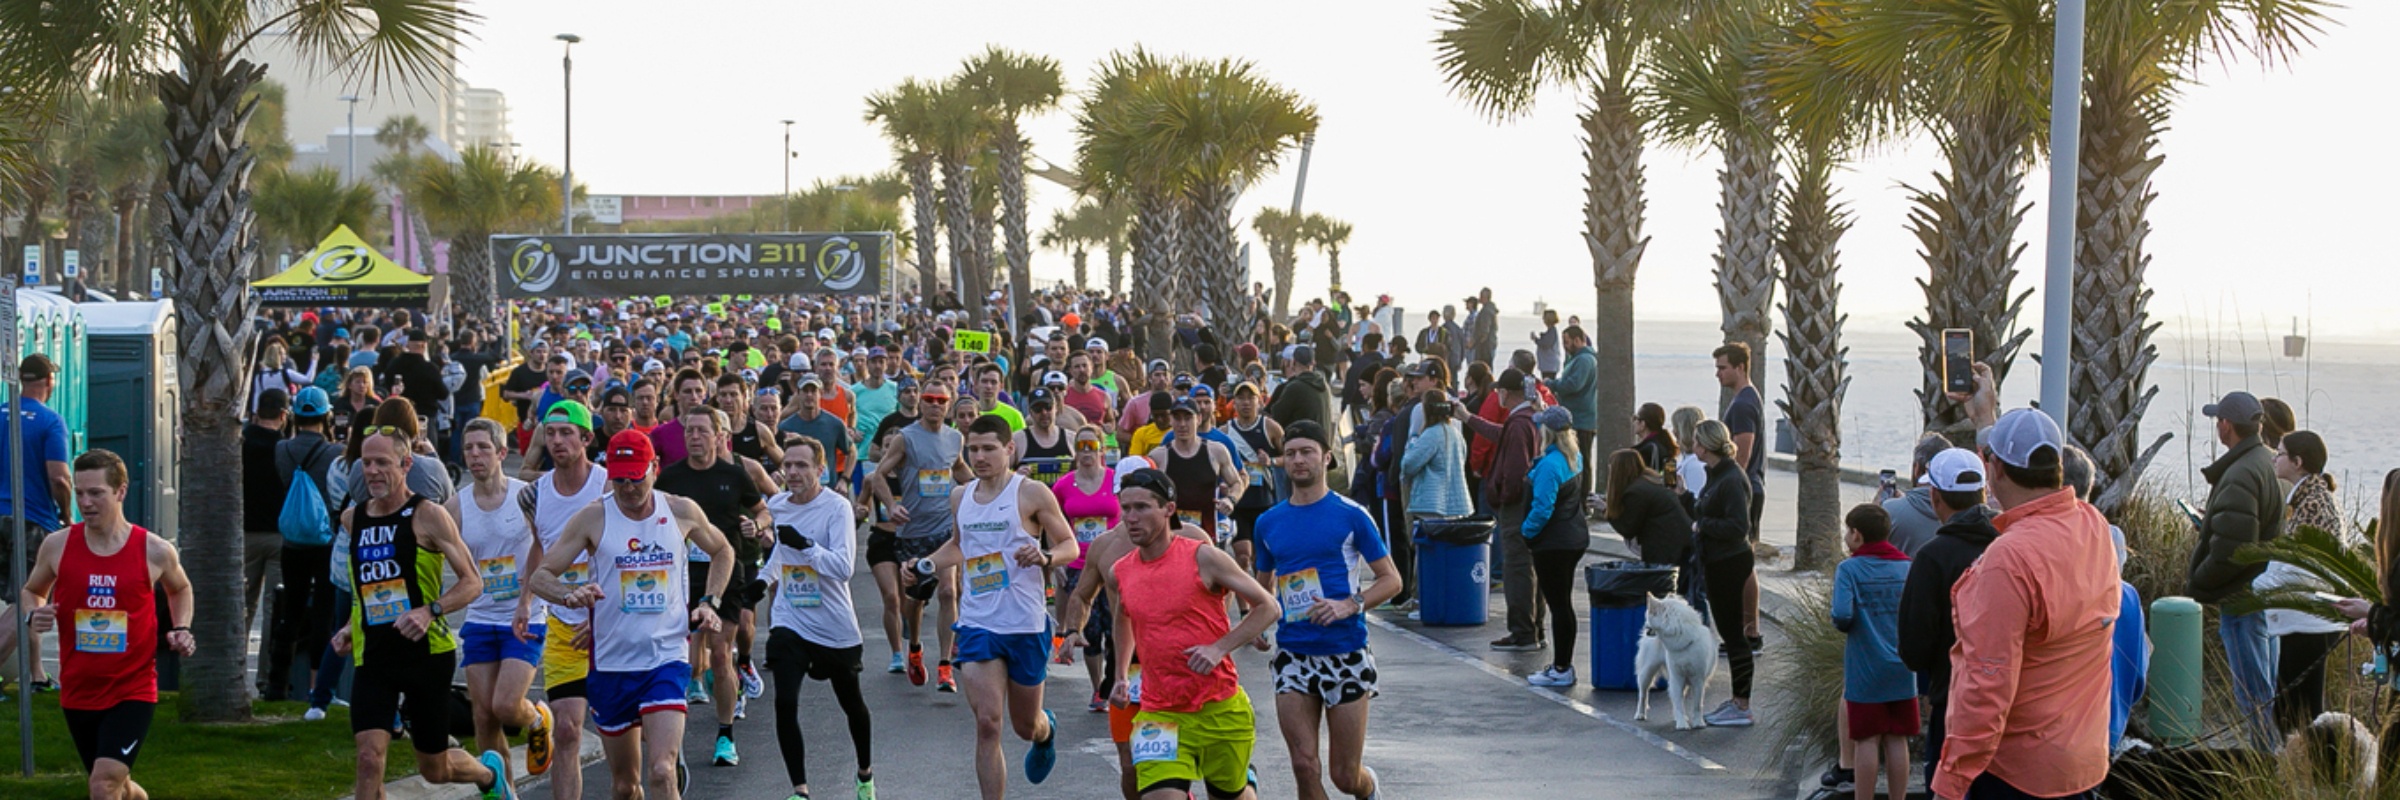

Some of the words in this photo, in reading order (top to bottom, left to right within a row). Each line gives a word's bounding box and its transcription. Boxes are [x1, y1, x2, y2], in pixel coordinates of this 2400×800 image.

[568, 243, 752, 266] JUNCTION
[759, 243, 807, 263] 311
[571, 268, 707, 280] ENDURANCE
[718, 268, 807, 279] SPORTS
[263, 287, 329, 297] JUNCTION
[330, 287, 349, 296] 311
[961, 338, 984, 351] 1:40
[358, 524, 398, 547] RUN
[363, 547, 390, 558] FOR
[615, 552, 674, 564] BOULDER
[360, 559, 402, 583] GOD
[89, 574, 118, 587] RUN
[92, 587, 112, 595] FOR
[87, 595, 117, 608] GOD
[626, 592, 666, 605] 3119
[80, 632, 120, 646] 5275
[1133, 741, 1172, 754] 4403
